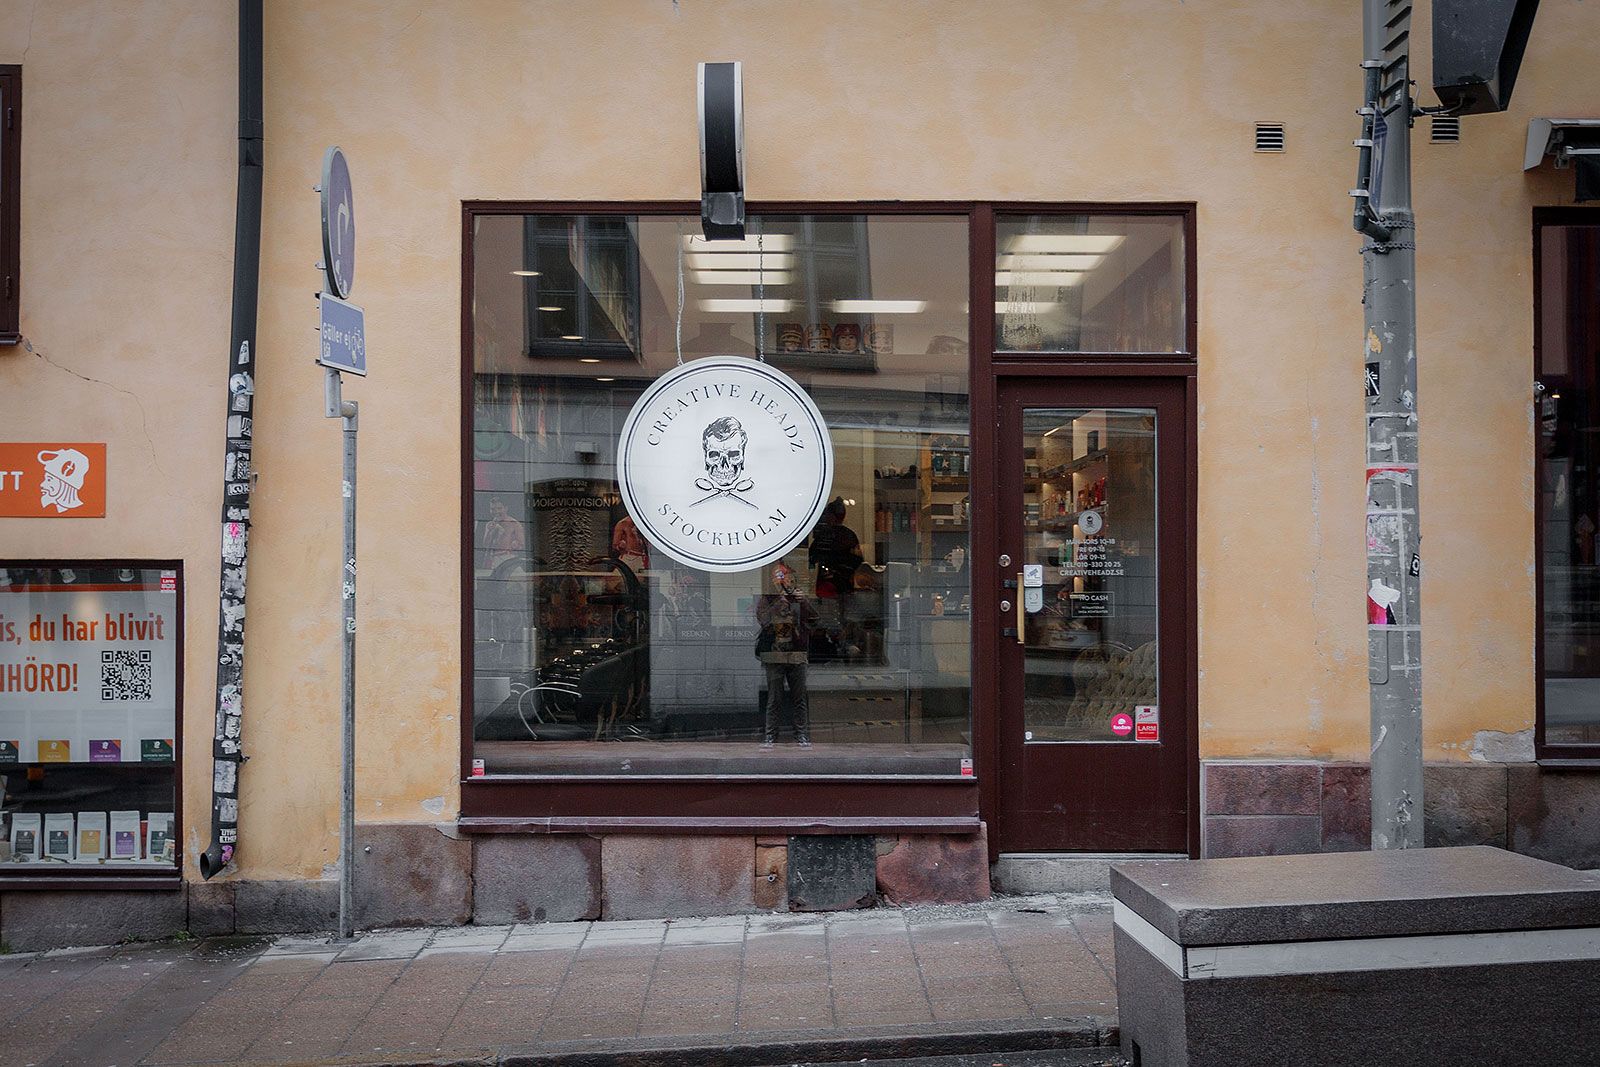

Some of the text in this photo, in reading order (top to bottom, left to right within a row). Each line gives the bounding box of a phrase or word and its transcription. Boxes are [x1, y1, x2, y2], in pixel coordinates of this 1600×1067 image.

[647, 383, 804, 453] CREATIVE HEADZ
[658, 503, 788, 546] STOCKHOLM
[29, 613, 56, 642] du
[62, 613, 98, 642] har
[105, 612, 165, 641] blivit
